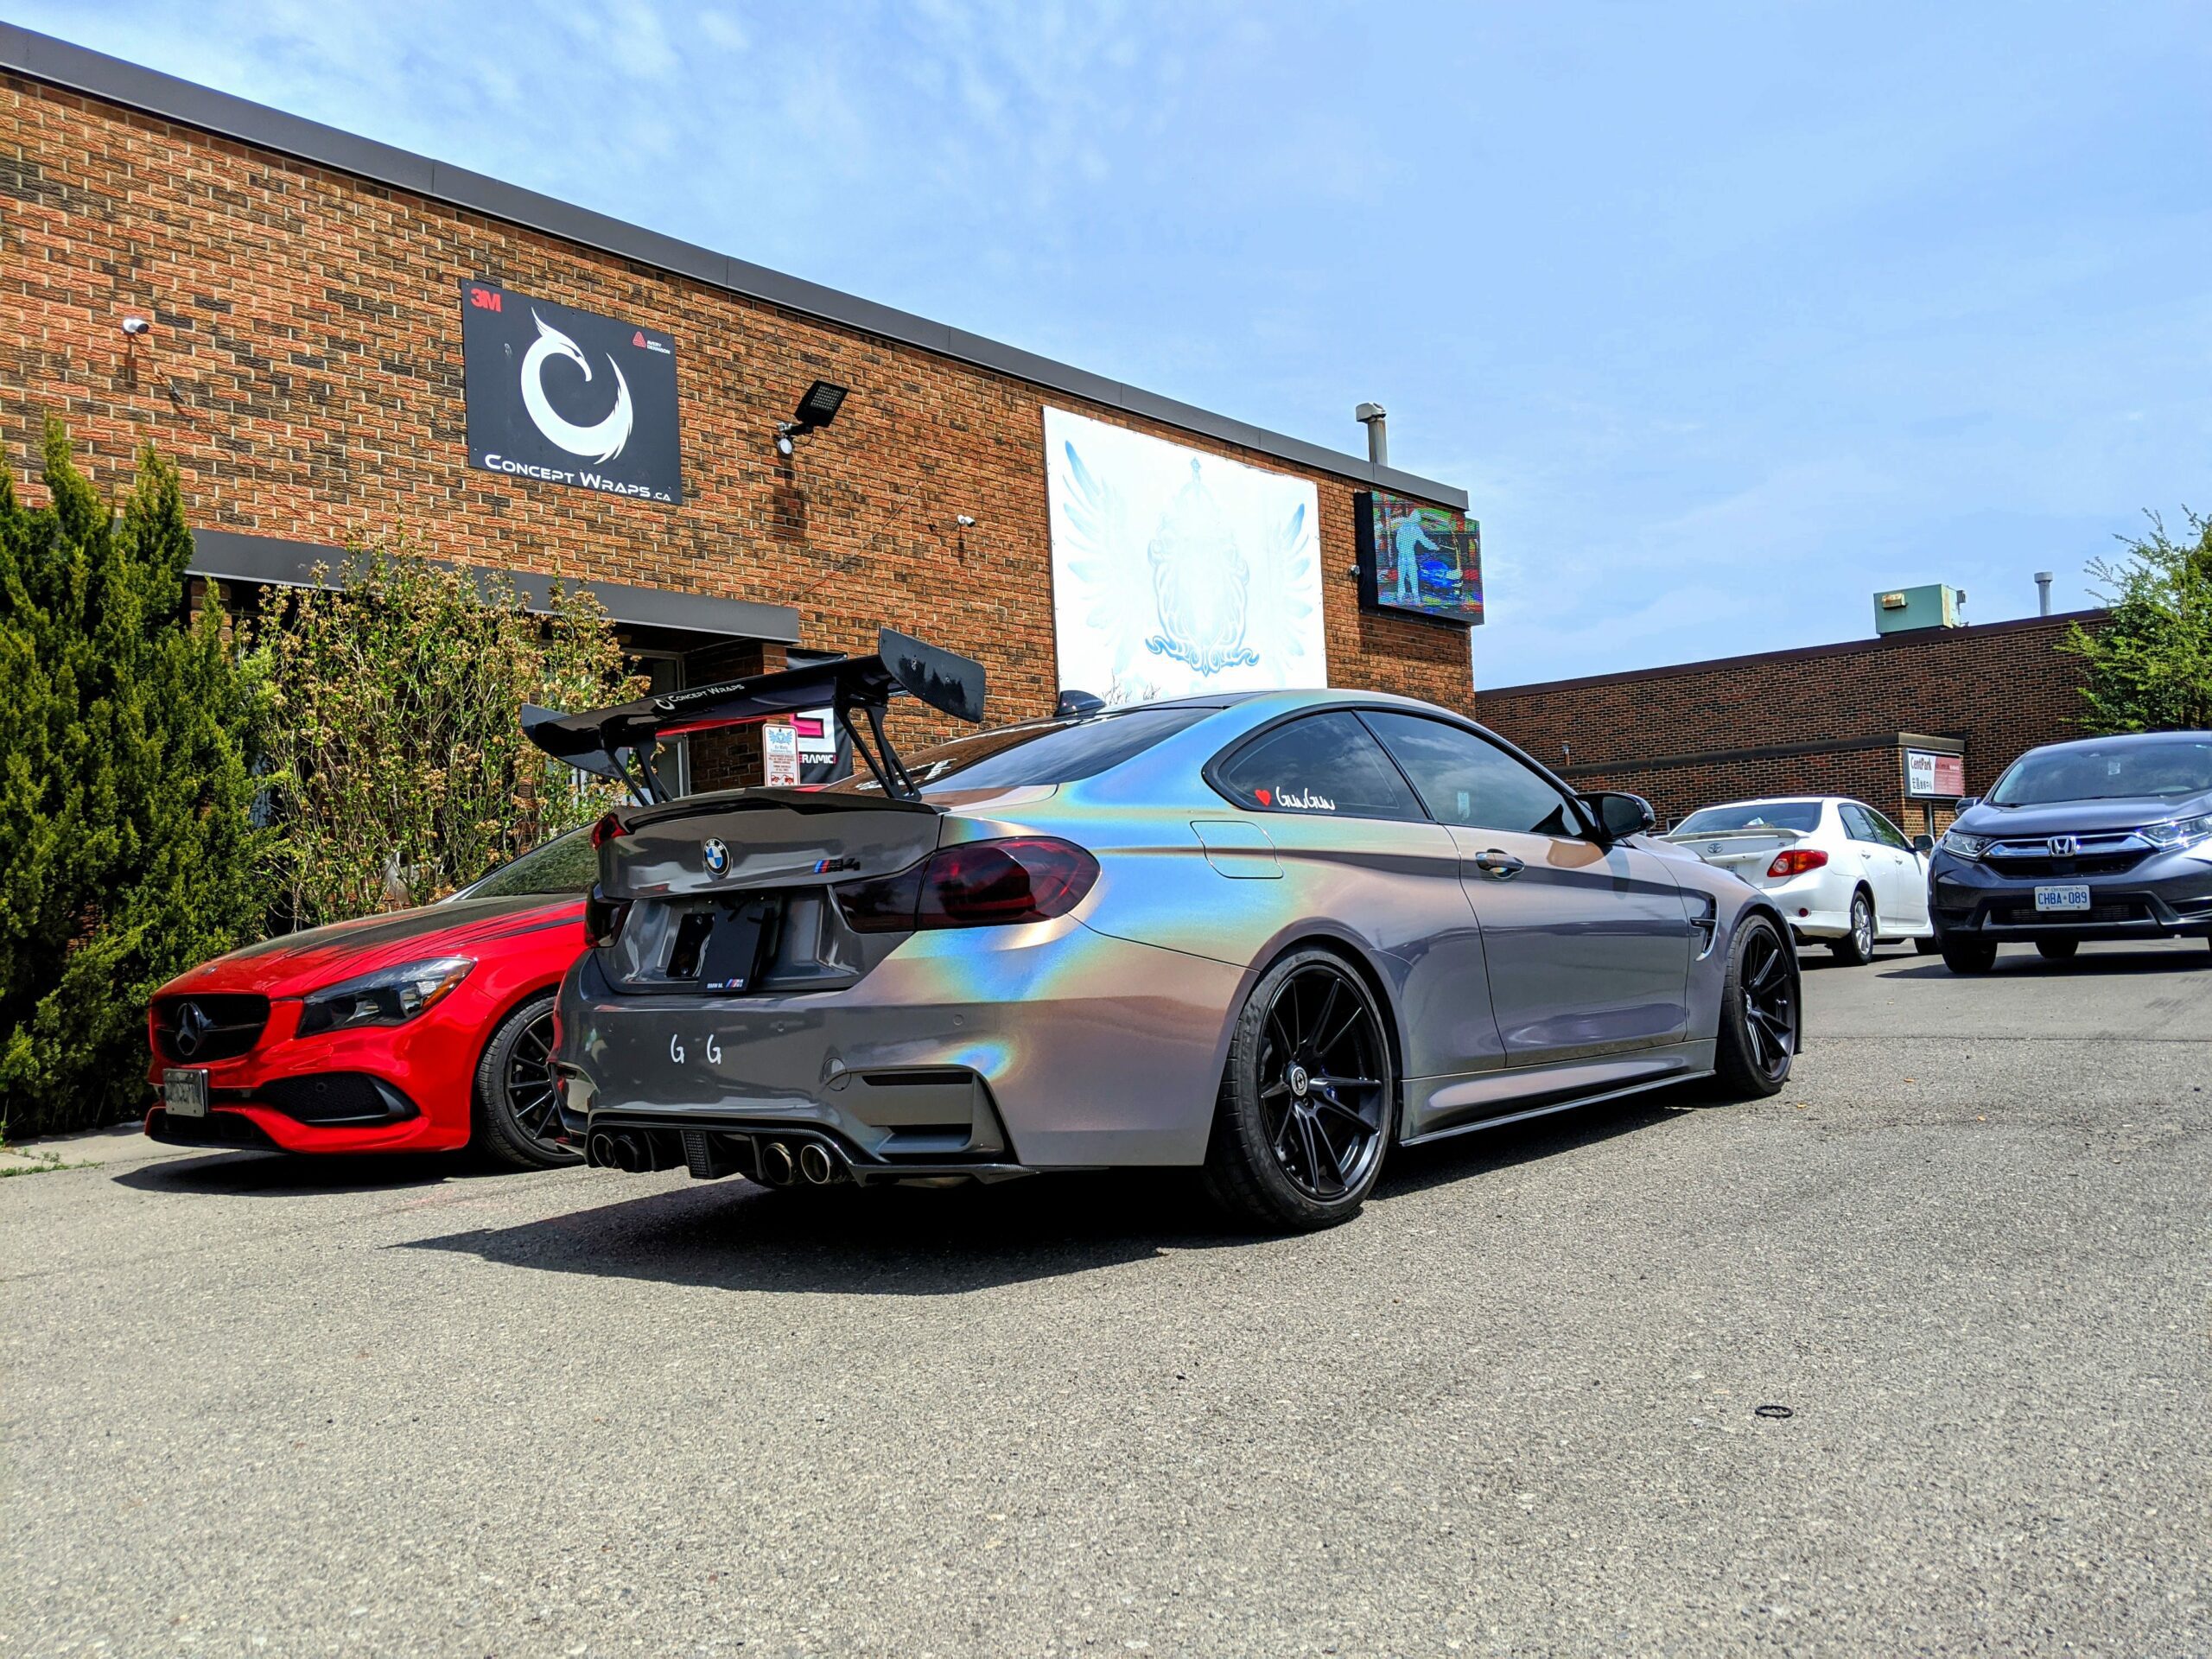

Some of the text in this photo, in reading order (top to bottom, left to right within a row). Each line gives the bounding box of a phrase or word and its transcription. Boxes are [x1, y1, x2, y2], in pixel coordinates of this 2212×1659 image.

[470, 288, 502, 312] 3M
[2037, 891, 2088, 906] CHBA 089
